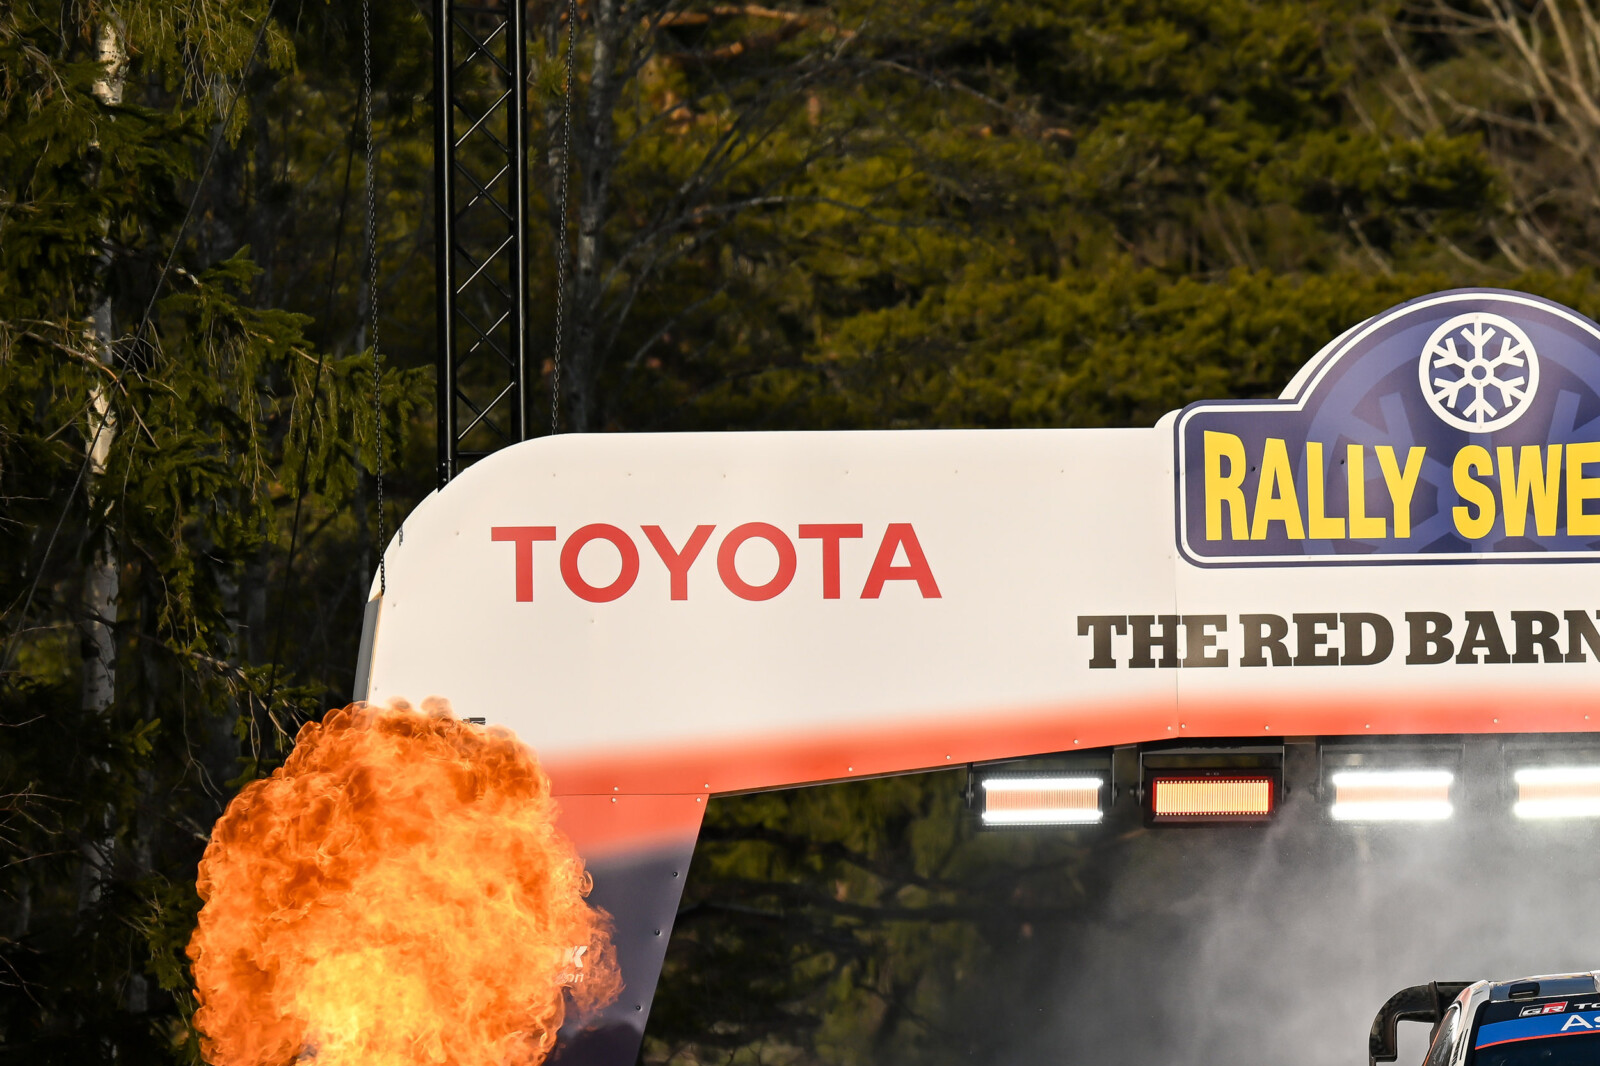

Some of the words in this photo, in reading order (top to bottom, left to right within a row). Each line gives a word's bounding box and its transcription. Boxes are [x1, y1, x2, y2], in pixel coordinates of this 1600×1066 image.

[1204, 430, 1426, 541] RALLY
[491, 521, 943, 603] TOYOTA
[1077, 613, 1229, 669] THE
[1239, 612, 1395, 667] RED
[1521, 1003, 1566, 1016] GR
